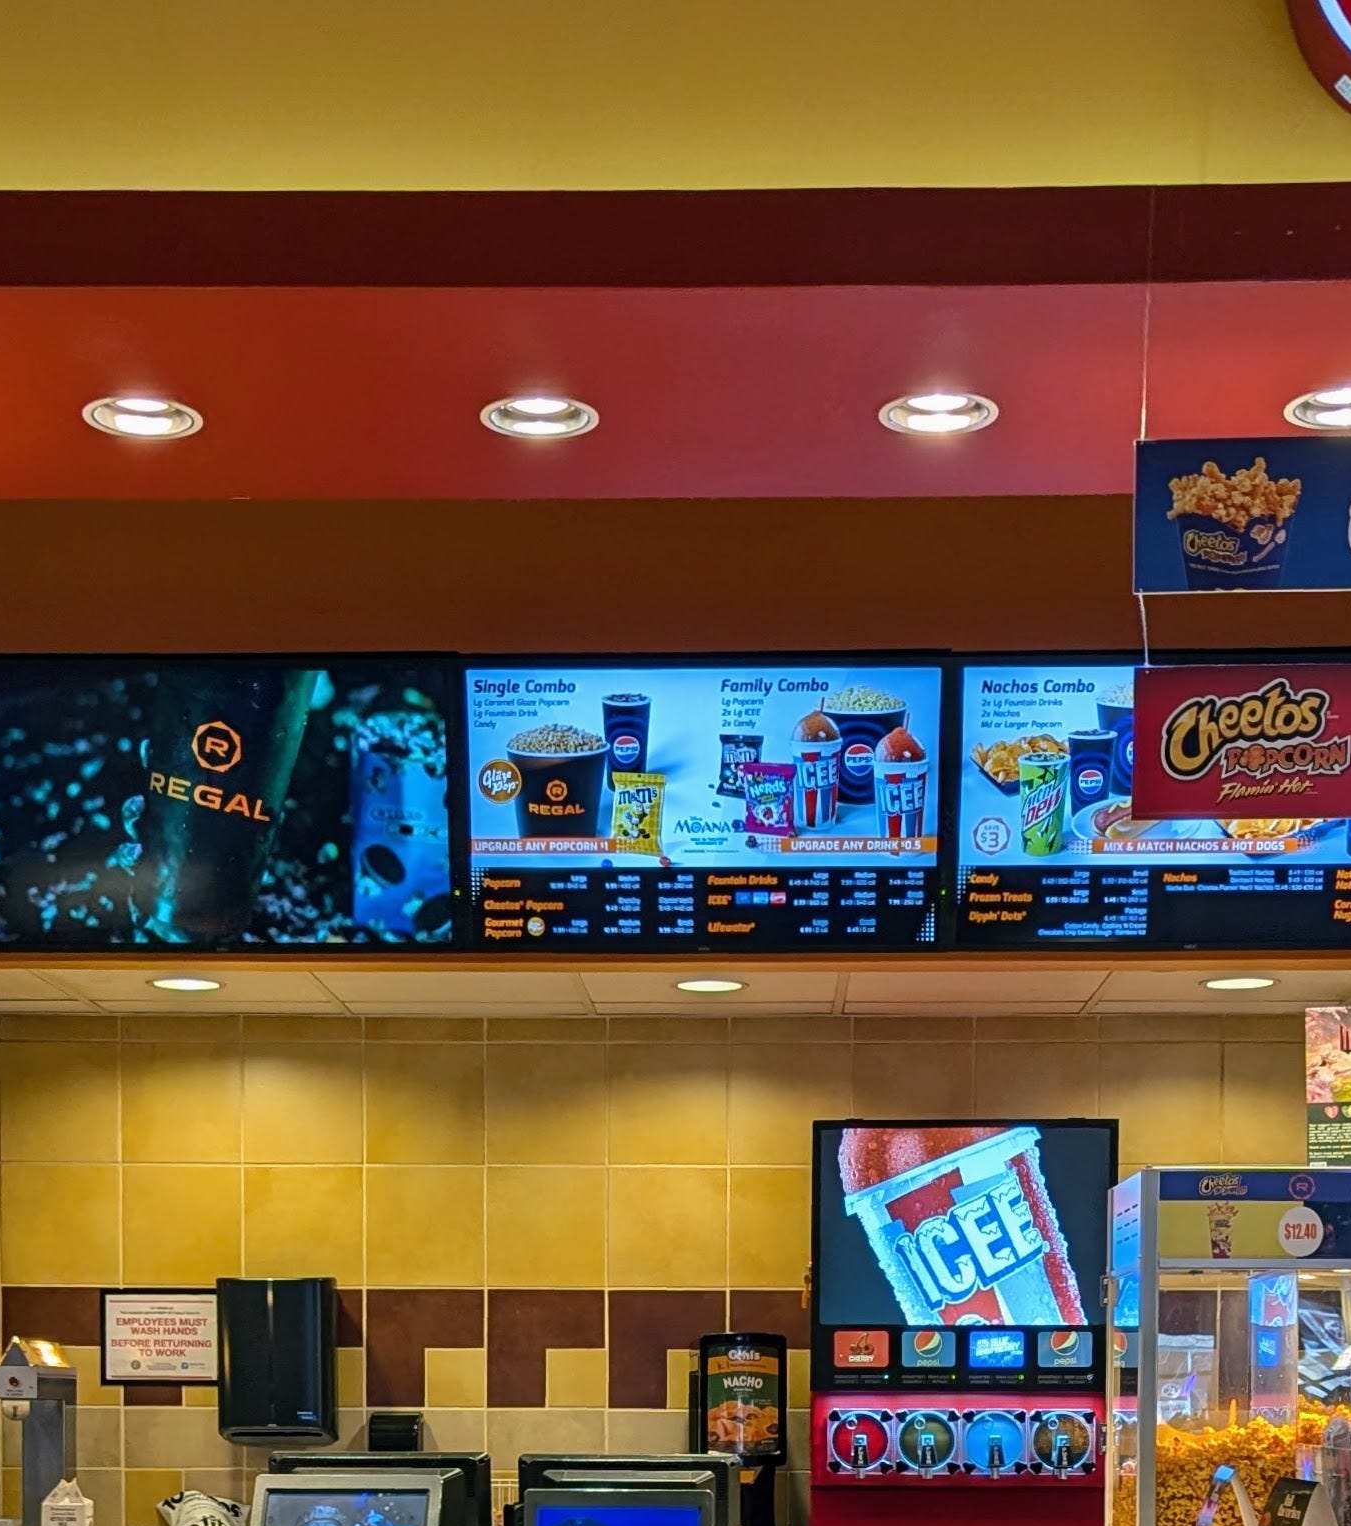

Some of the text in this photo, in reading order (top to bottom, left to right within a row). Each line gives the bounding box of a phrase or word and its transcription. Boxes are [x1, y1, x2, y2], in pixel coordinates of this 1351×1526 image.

[1185, 531, 1237, 554] Cheetos
[474, 679, 576, 697] Single Combo
[721, 678, 829, 697] Family Combo
[982, 679, 1095, 693] Nachos Combo
[1167, 682, 1321, 776] Cheetos
[1224, 742, 1349, 774] POPCORN
[799, 759, 839, 789] ICEE
[1282, 779, 1311, 796] Hot
[149, 772, 270, 822] REGAL
[880, 779, 924, 816] ICEE
[528, 803, 585, 816] REGAL
[474, 842, 597, 851] UPGRADE ANY POPCORN
[791, 840, 898, 850] UPGRADE ANY DRINK
[980, 832, 999, 848] $3
[1104, 841, 1285, 851] MIX & MATCH NACHOS & HOT DOGS
[1200, 1173, 1240, 1195] Cheetos
[1284, 1224, 1317, 1240] $12.40
[895, 1177, 1045, 1310] ICEE
[116, 1318, 208, 1327] EMPLOYEES MUST
[131, 1327, 198, 1336] WASH HANDS
[111, 1339, 212, 1348] BEFORE RETURNING
[156, 1349, 187, 1357] WORK
[916, 1358, 940, 1367] pepsi
[1053, 1357, 1078, 1366] pepsi
[722, 1375, 763, 1389] NACHO
